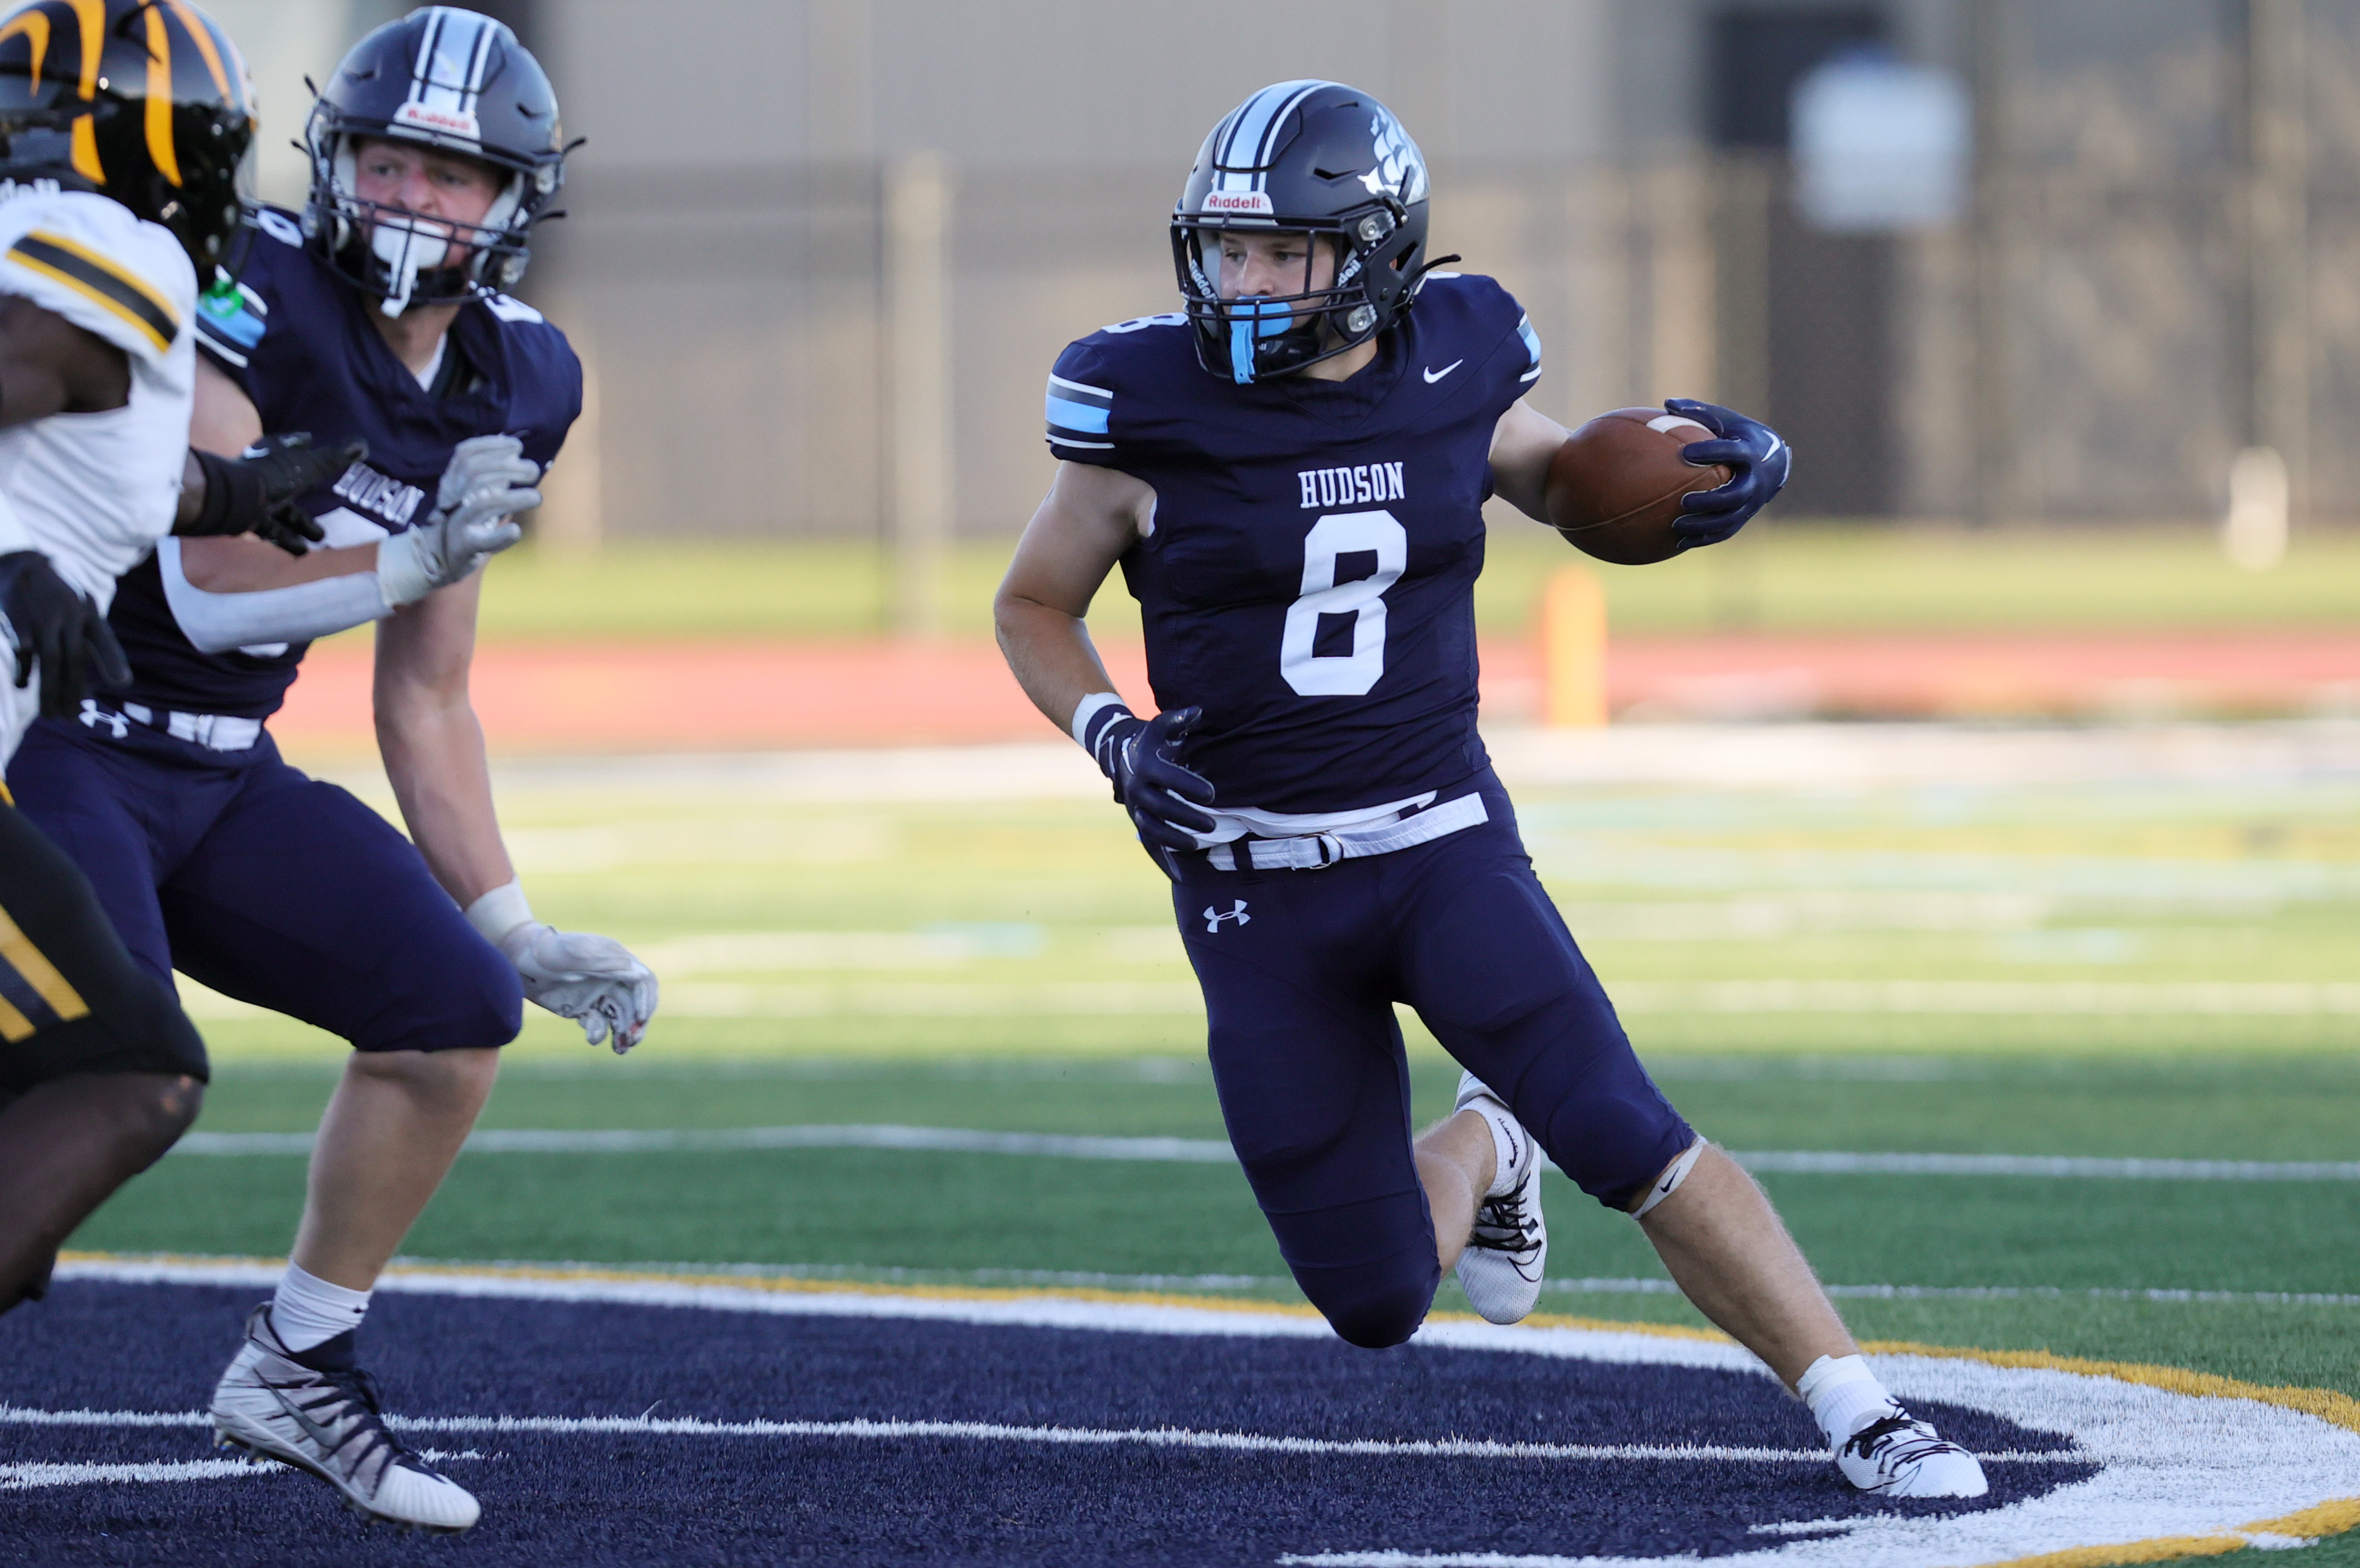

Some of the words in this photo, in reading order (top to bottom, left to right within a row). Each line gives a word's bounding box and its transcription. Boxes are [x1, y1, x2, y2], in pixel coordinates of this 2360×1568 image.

[1209, 195, 1261, 208] Riddell
[332, 462, 425, 526] HUDSON
[1298, 462, 1405, 508] HUDSON
[1280, 510, 1407, 696] 8
